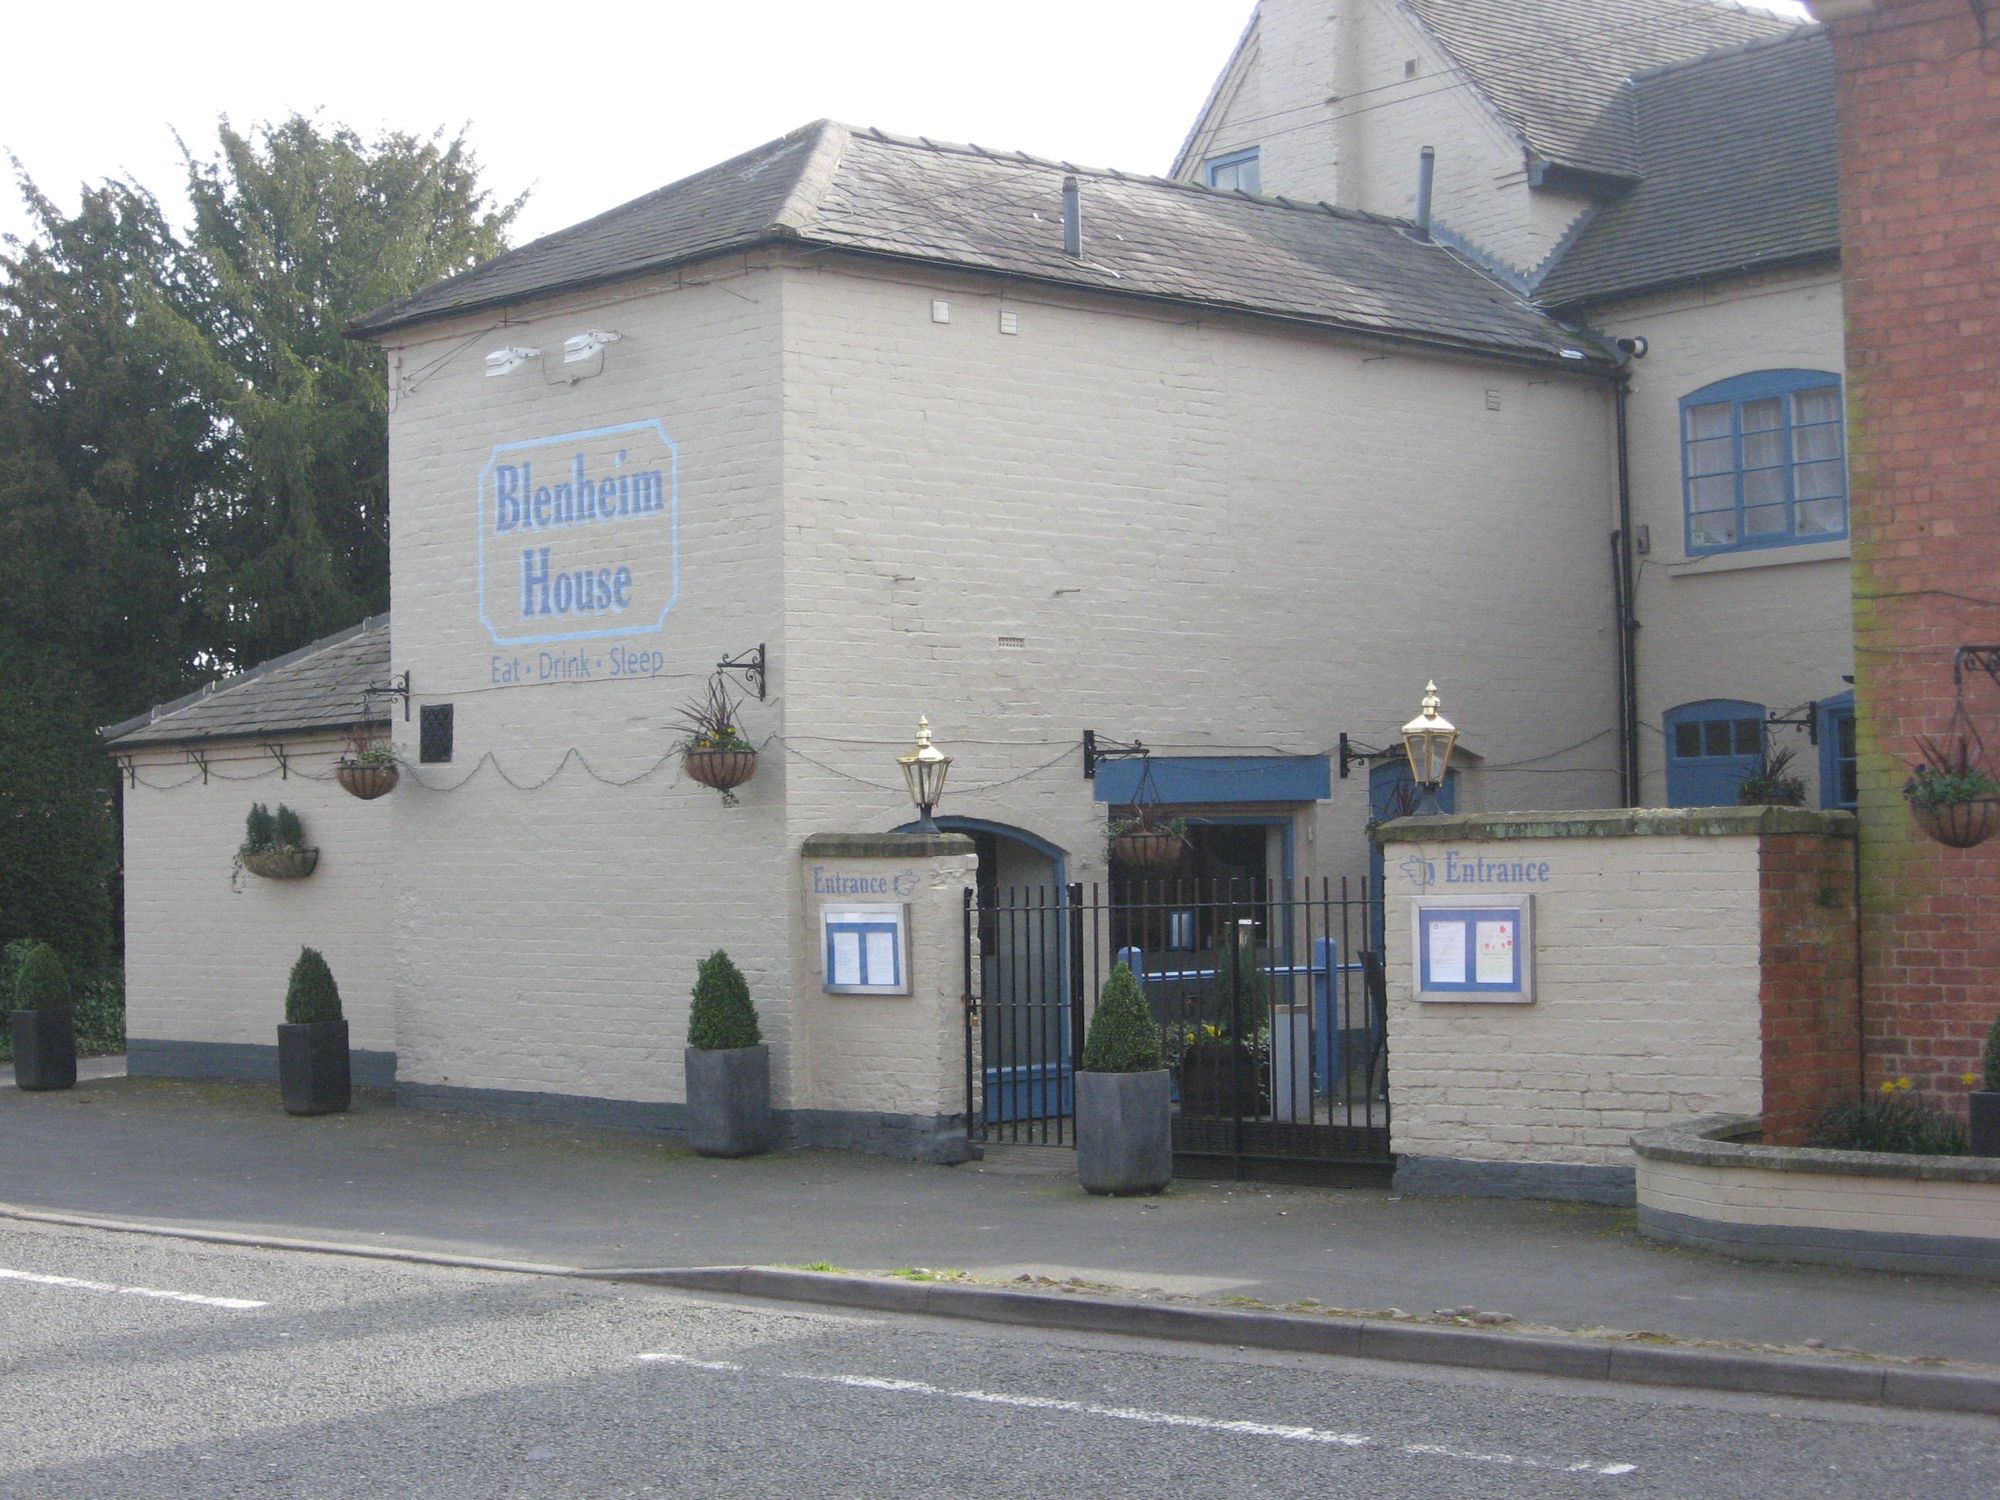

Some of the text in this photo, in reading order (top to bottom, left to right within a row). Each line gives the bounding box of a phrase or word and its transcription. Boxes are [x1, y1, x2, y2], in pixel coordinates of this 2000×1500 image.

[495, 449, 665, 533] Blenheim
[521, 547, 633, 617] House
[491, 646, 664, 684] Eat Drink Sleep
[812, 866, 888, 894] Entrance
[1445, 851, 1550, 883] Entrance
